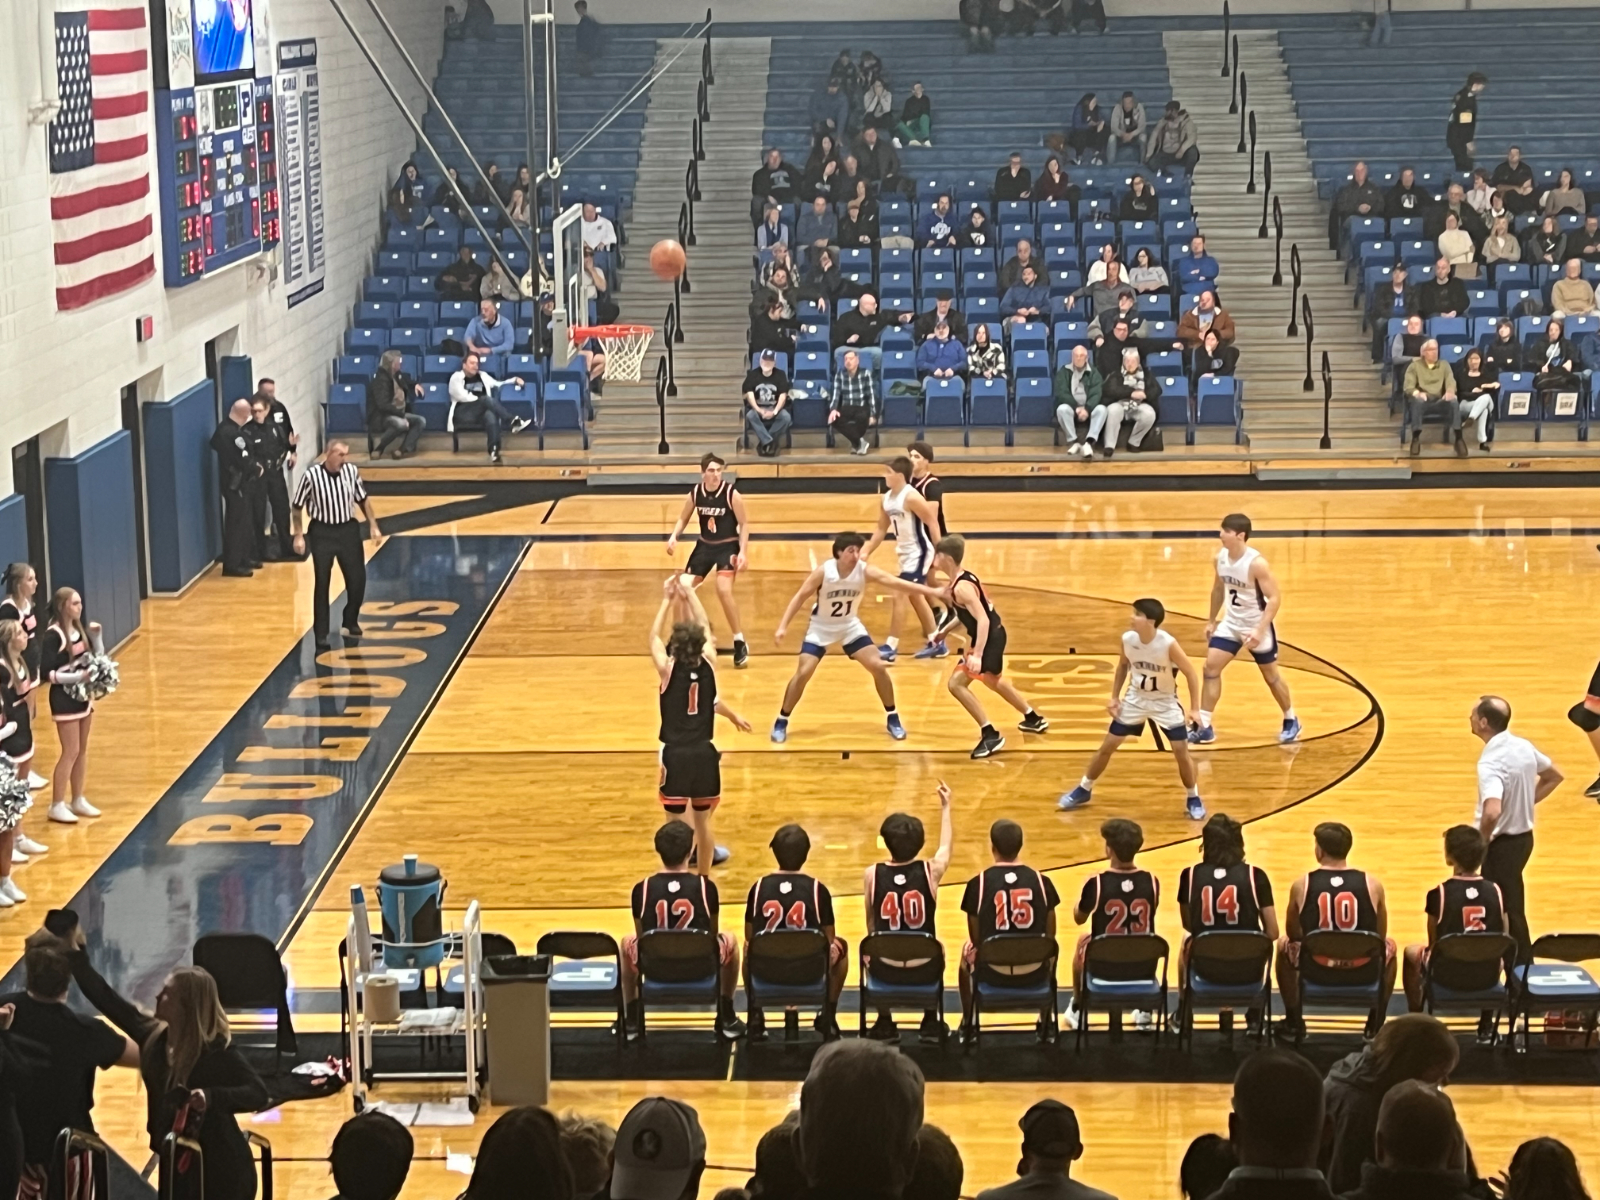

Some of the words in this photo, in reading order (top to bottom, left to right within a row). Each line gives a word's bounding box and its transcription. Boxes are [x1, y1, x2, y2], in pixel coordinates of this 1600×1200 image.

[697, 506, 727, 517] TIGERS
[830, 600, 853, 618] 21
[1229, 588, 1242, 607] 2
[686, 681, 699, 716] 1
[165, 600, 460, 846] BULLDOGS
[654, 897, 695, 930] 12
[761, 899, 807, 931] 24
[880, 888, 925, 931] 40
[993, 888, 1034, 930] 15
[1104, 898, 1151, 934] 23
[1200, 884, 1240, 927] 14
[1317, 890, 1359, 931] 10
[1461, 905, 1487, 931] 5
